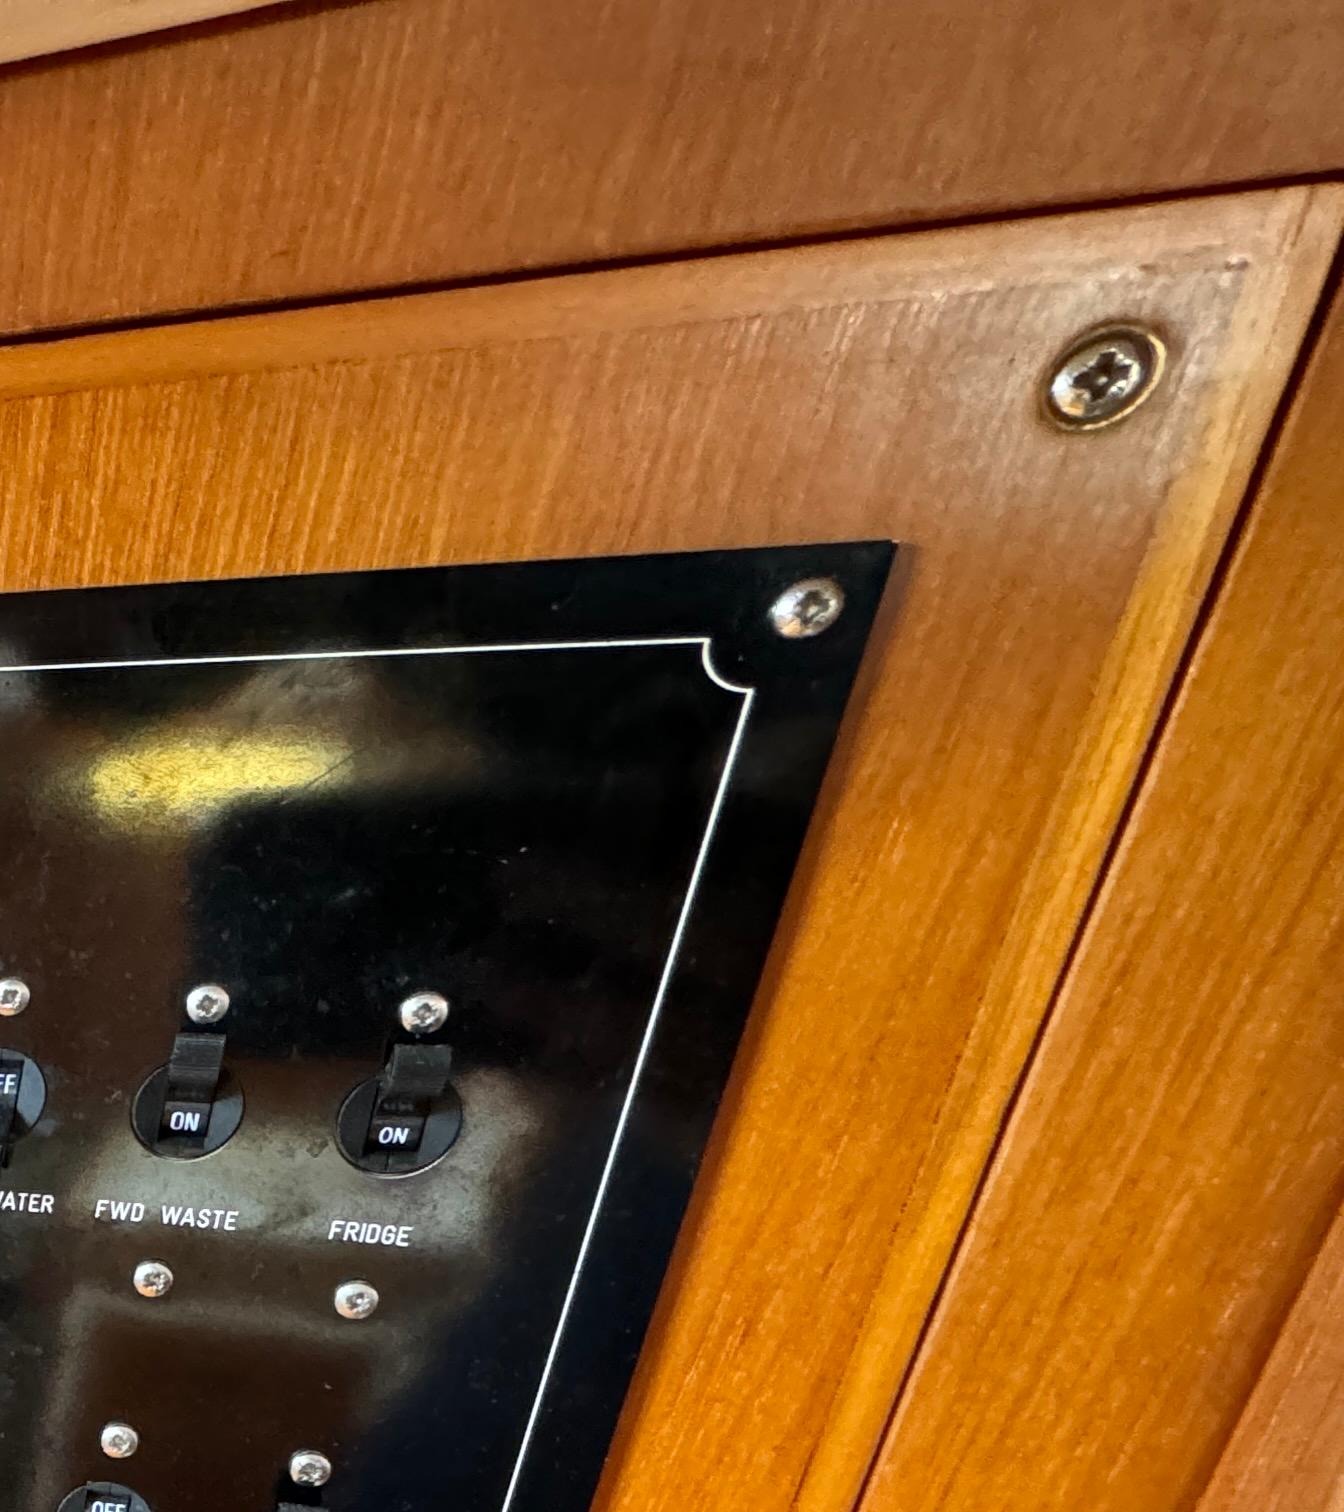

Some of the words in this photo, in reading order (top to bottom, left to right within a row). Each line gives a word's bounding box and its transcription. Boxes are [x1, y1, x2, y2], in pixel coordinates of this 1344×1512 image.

[169, 1111, 200, 1132] ON
[378, 1126, 409, 1145] ON
[94, 1199, 145, 1223] FWD
[161, 1204, 239, 1231] WASTE
[328, 1219, 414, 1247] FRIDGE
